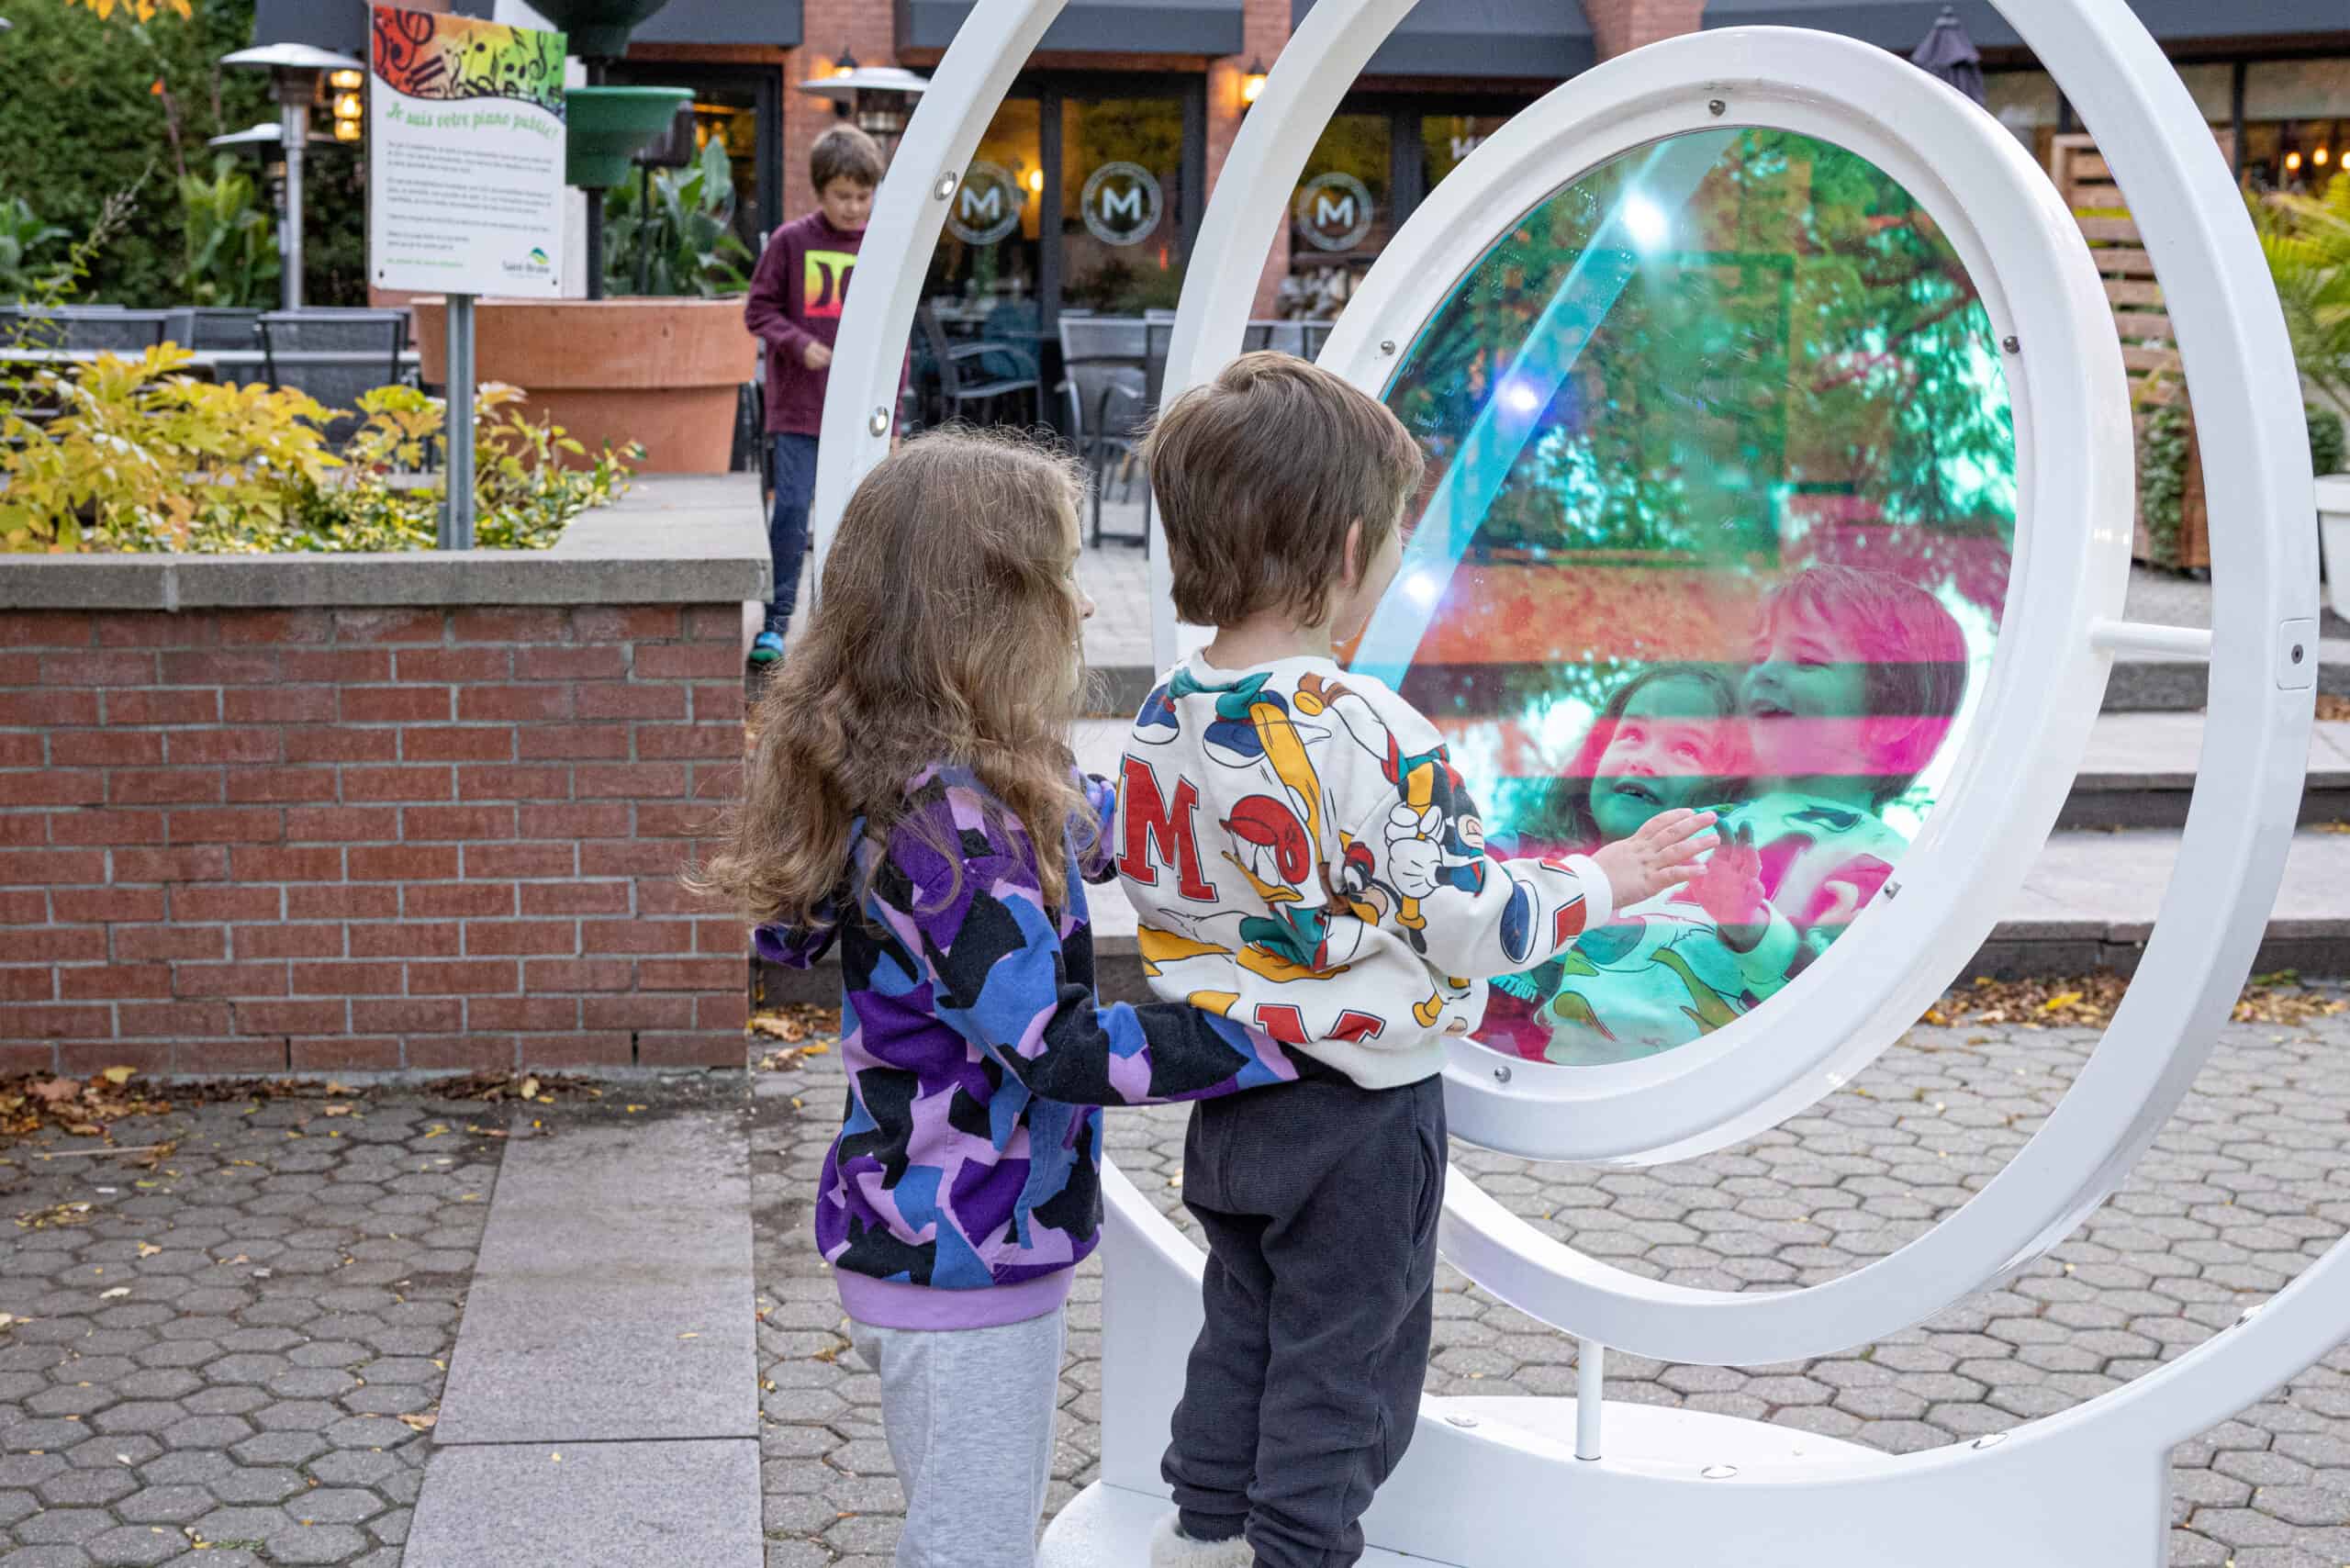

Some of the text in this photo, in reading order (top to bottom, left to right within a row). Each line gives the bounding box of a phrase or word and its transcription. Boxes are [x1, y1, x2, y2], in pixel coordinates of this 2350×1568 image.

[473, 110, 510, 129] piano
[960, 185, 1001, 220] M
[1101, 186, 1141, 221] M
[1316, 196, 1354, 228] M
[1116, 752, 1219, 903] M
